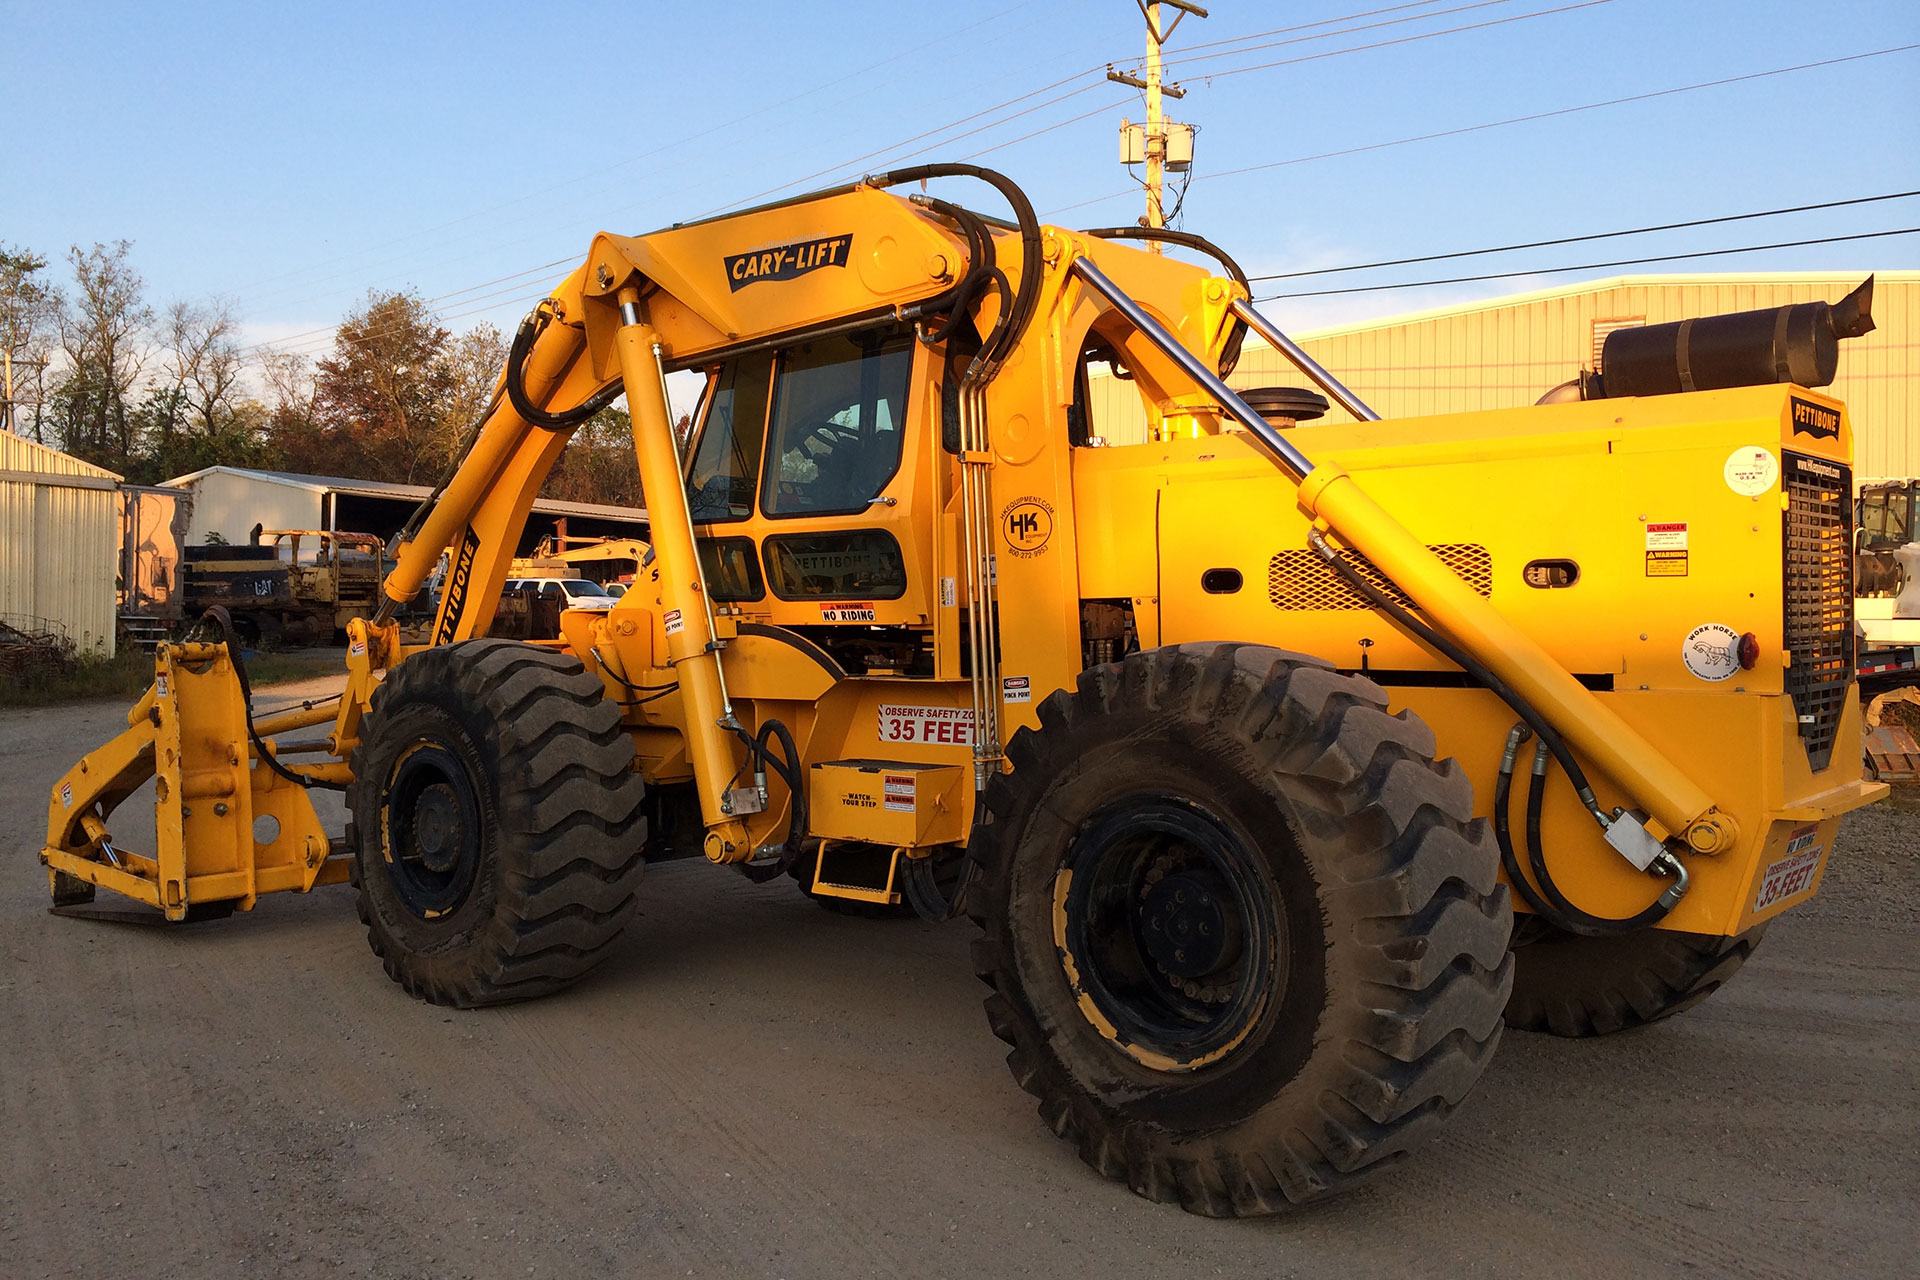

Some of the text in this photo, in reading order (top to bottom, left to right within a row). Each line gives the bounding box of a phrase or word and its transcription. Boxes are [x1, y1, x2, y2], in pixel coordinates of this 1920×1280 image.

[732, 240, 841, 280] CARY-LIFT
[1795, 403, 1837, 432] PETTIBONE
[1000, 495, 1055, 520] HKEQUIPMENT.COM
[1010, 512, 1038, 540] HK
[439, 540, 474, 646] ETTIBONE
[823, 610, 874, 621] NO RIDING
[1688, 625, 1738, 641] WORK HORSE
[885, 707, 985, 720] OBSERVE SAFETY ZO
[889, 719, 984, 745] 35 FEET
[861, 800, 877, 808] STEP
[1760, 863, 1813, 907] 35 FEET
